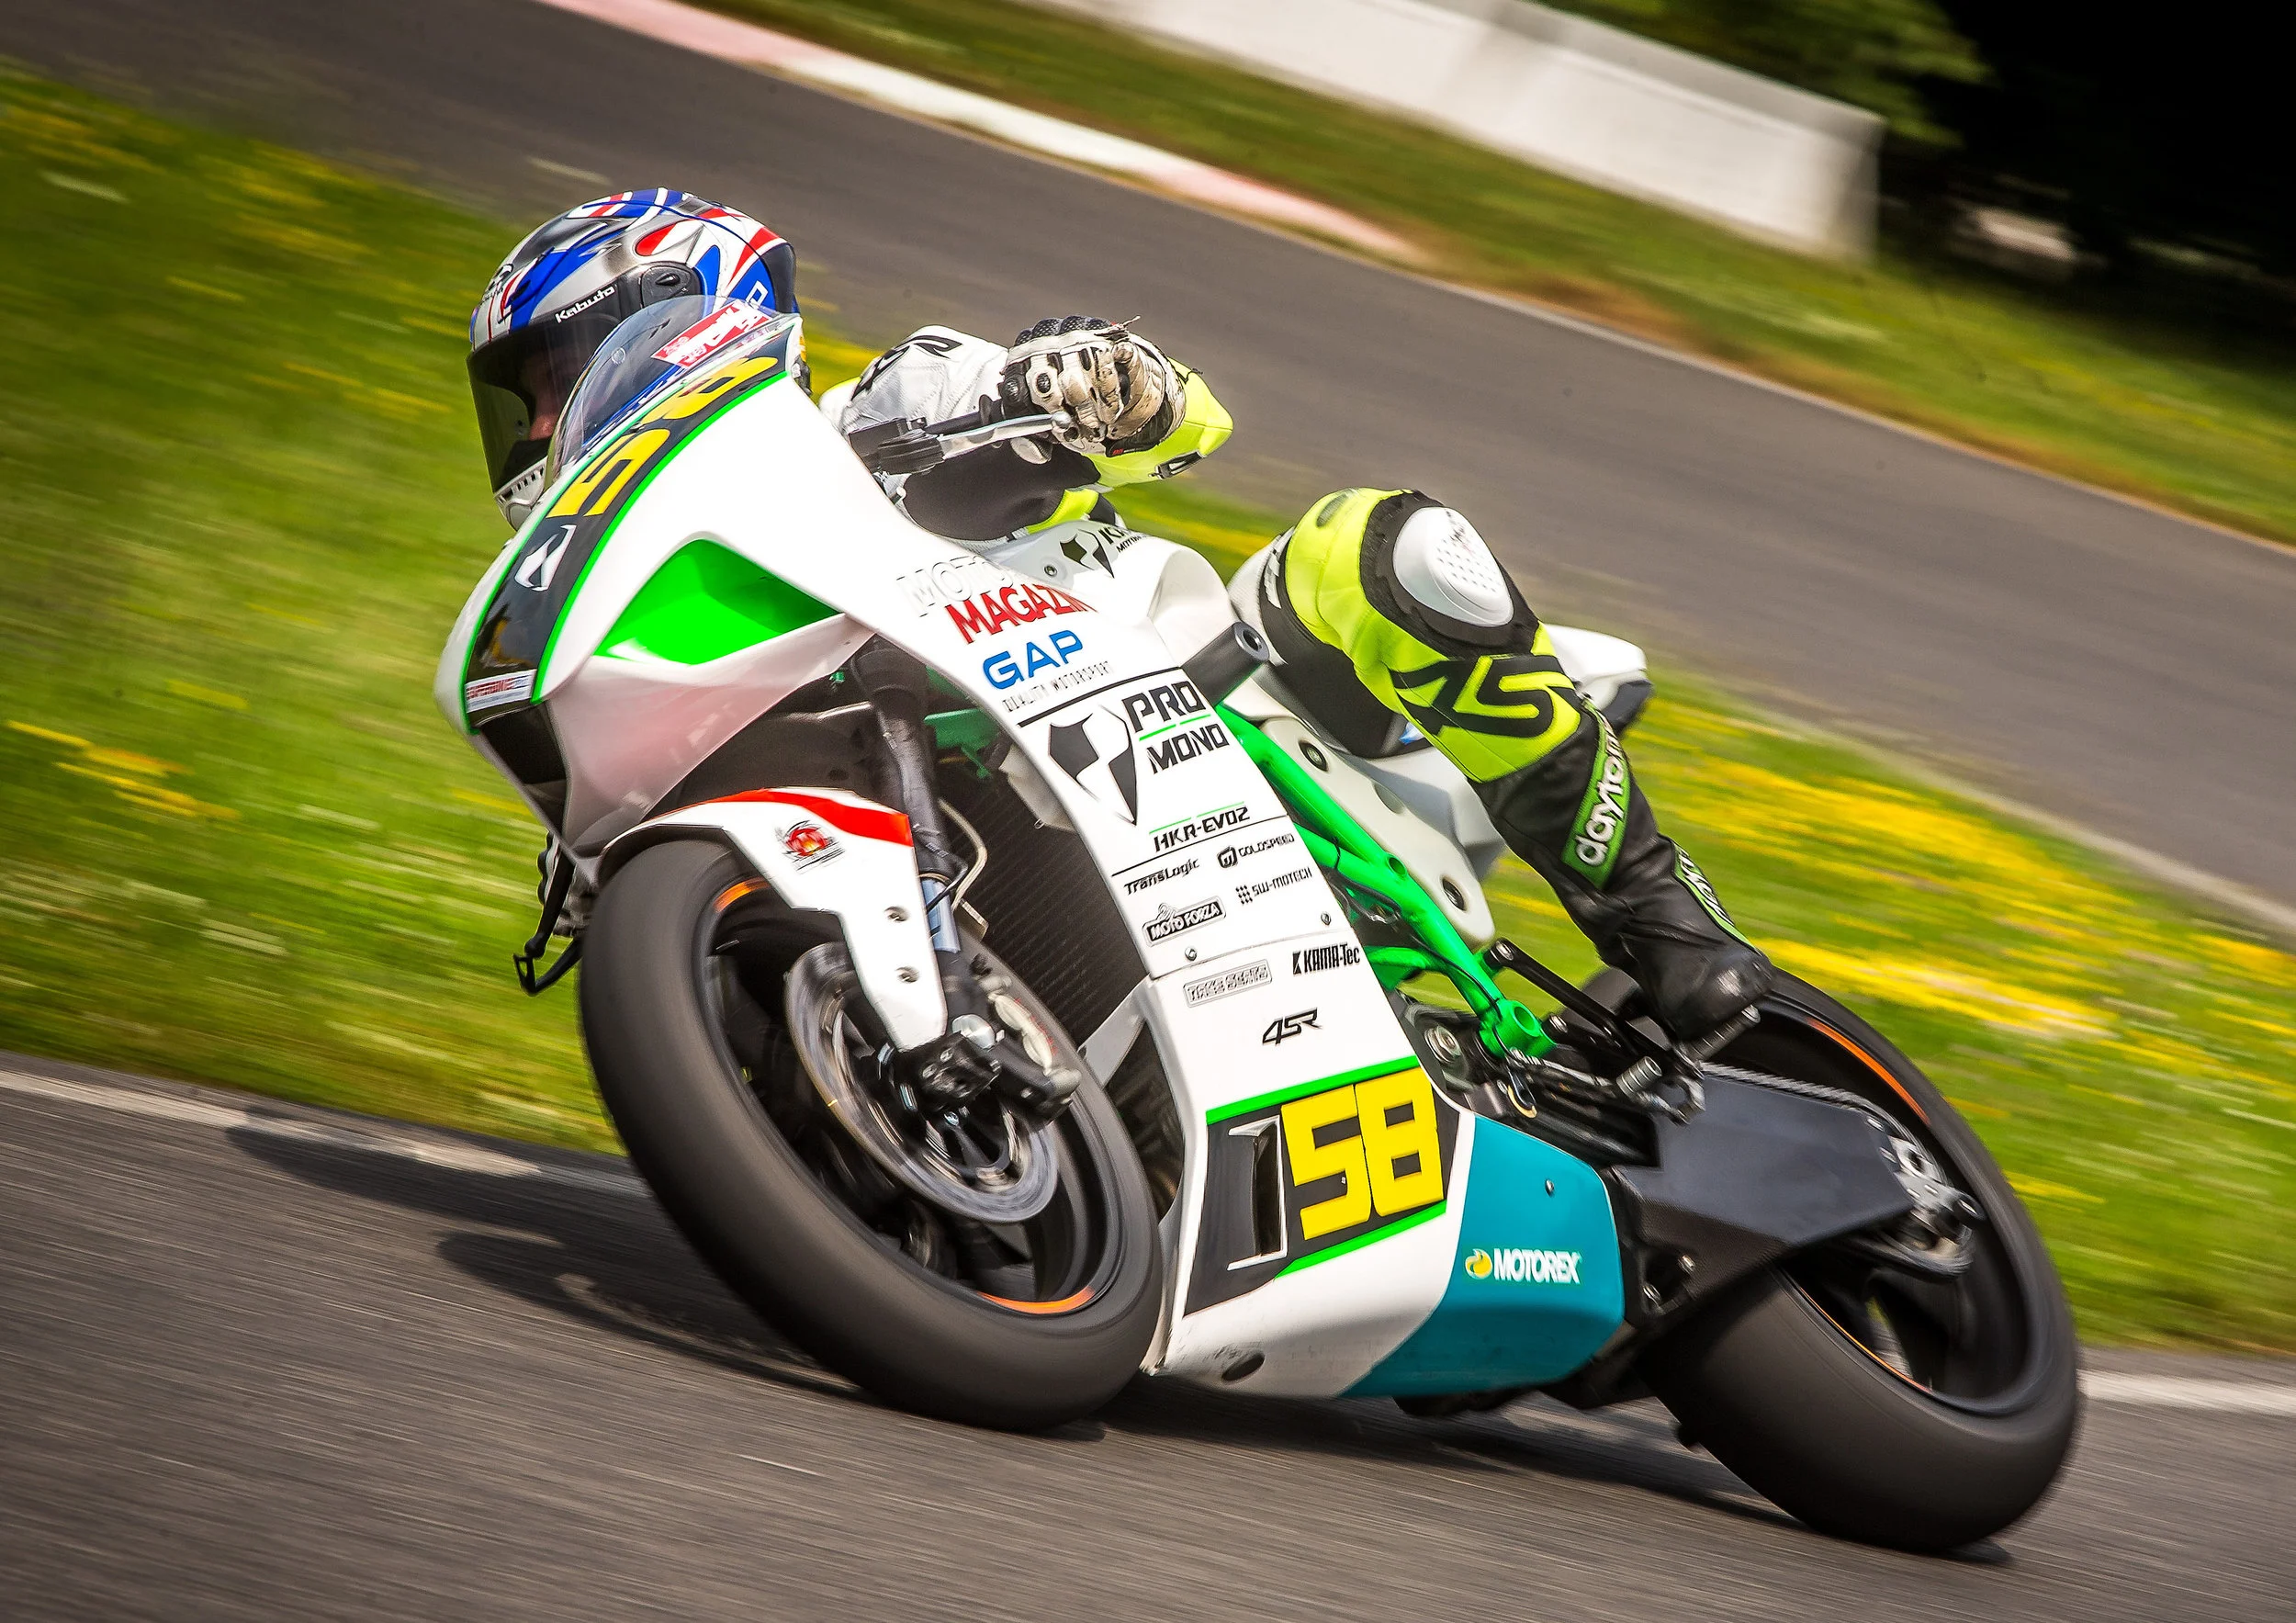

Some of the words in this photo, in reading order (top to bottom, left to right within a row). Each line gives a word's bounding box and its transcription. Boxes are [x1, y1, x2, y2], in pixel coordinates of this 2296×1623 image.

[555, 286, 616, 323] Kabuto
[983, 629, 1084, 689] GAP
[1121, 680, 1206, 734] PRO
[1145, 722, 1231, 775] MONO
[1123, 858, 1200, 896] TransLogic
[1251, 866, 1312, 896] SW-MOTECH
[1150, 916, 1185, 941] MOTO
[1183, 903, 1221, 927] FORZA
[1280, 1066, 1445, 1241] 58
[1493, 1247, 1583, 1285] MOTOREX
